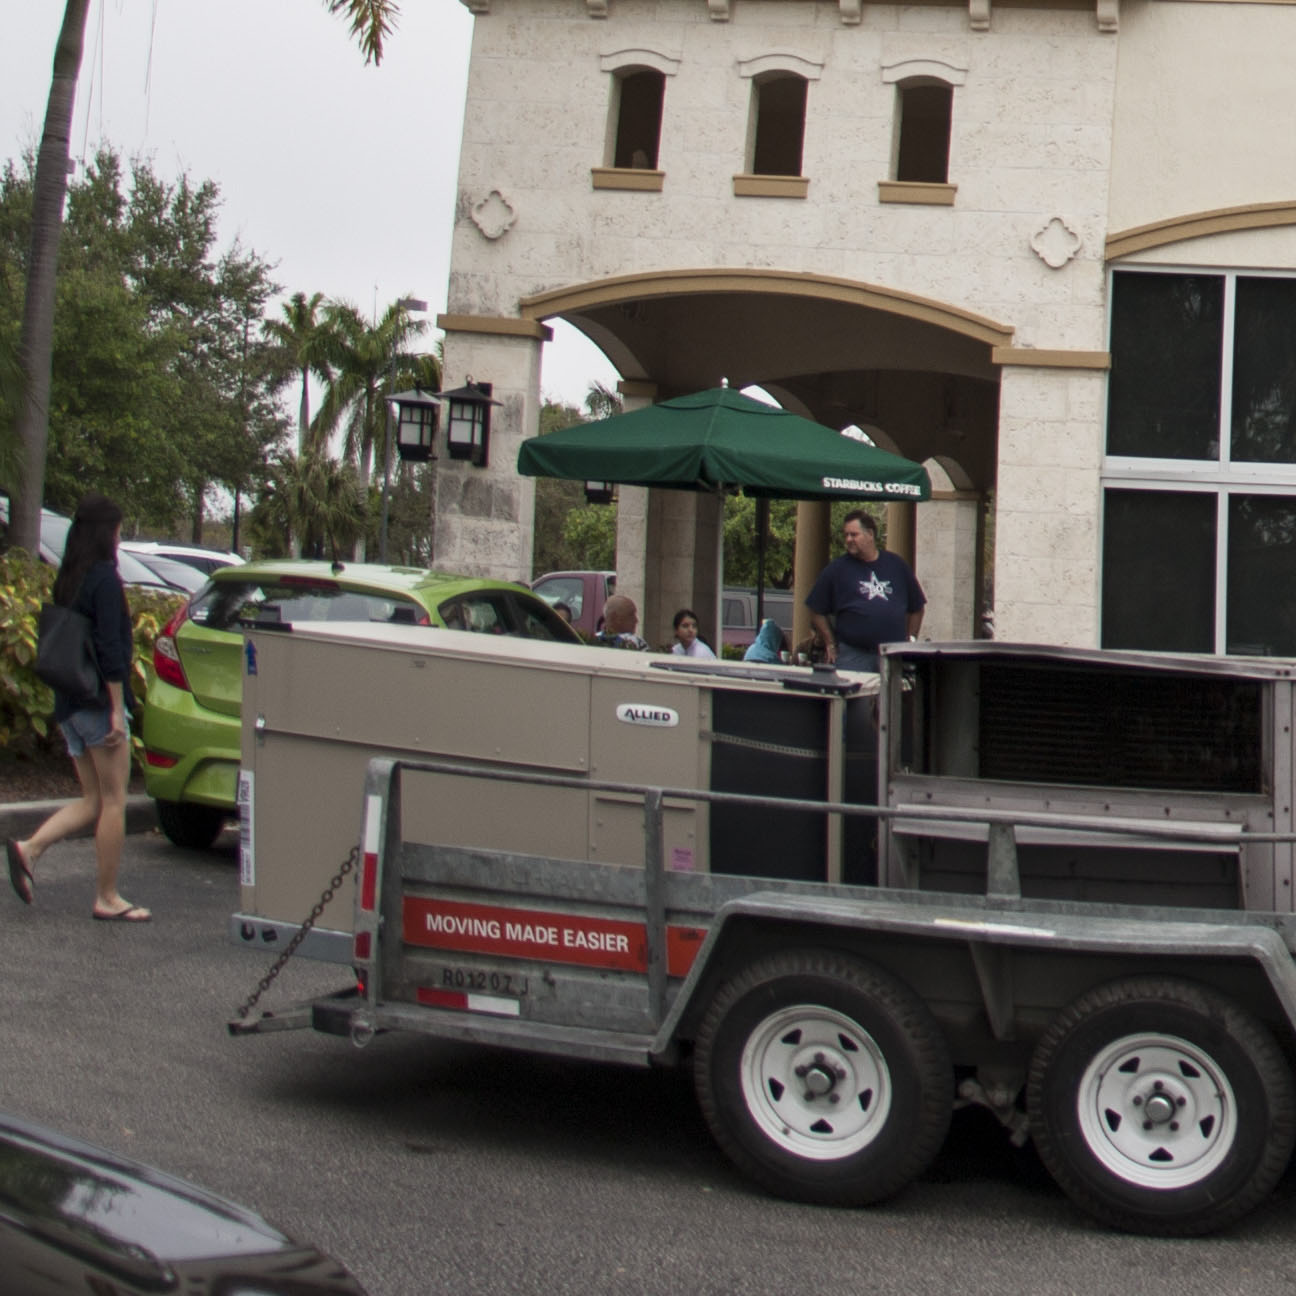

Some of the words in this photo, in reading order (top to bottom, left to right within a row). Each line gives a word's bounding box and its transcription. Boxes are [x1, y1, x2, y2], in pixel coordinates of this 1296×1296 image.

[823, 477, 883, 492] STARBUCKS
[885, 483, 921, 496] COFFEE
[624, 708, 671, 721] ALLIED
[426, 913, 501, 940] MOVING
[505, 923, 559, 946] MADE
[563, 929, 629, 953] EASIER
